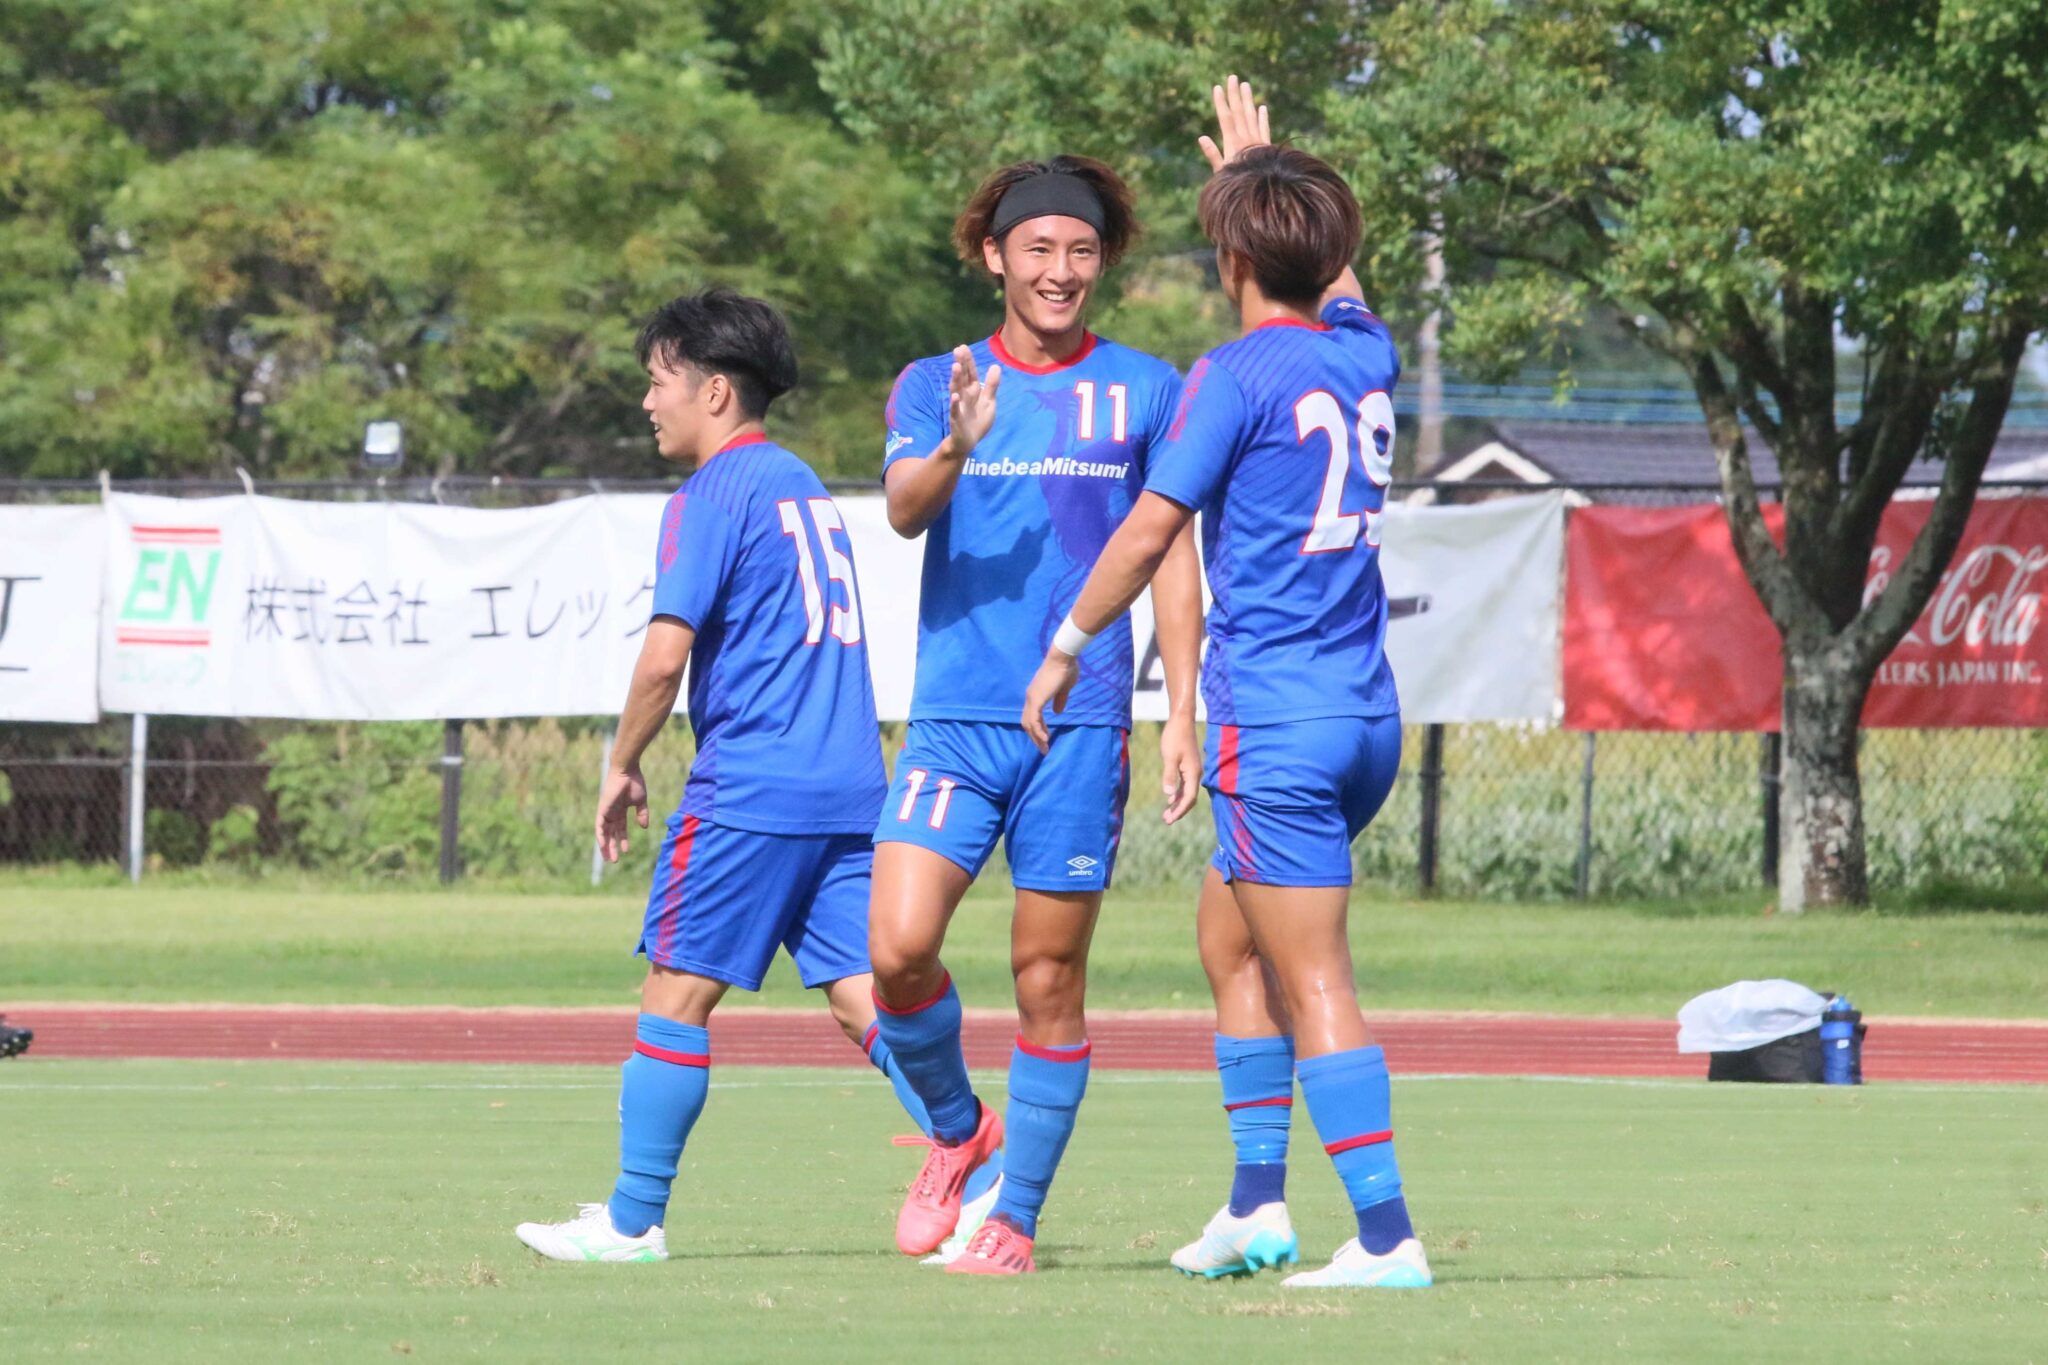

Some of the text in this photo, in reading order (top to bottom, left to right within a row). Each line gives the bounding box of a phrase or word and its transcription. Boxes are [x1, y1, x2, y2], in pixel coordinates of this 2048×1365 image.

[1073, 379, 1128, 444] 11
[1293, 388, 1397, 556] 29
[120, 548, 222, 622] EN
[777, 496, 861, 646] 15
[242, 572, 430, 645] 株式会社
[1876, 661, 1931, 685] LERS
[1936, 661, 1999, 689] JAPAN
[898, 768, 957, 831] 11
[1068, 869, 1094, 877] umbro
